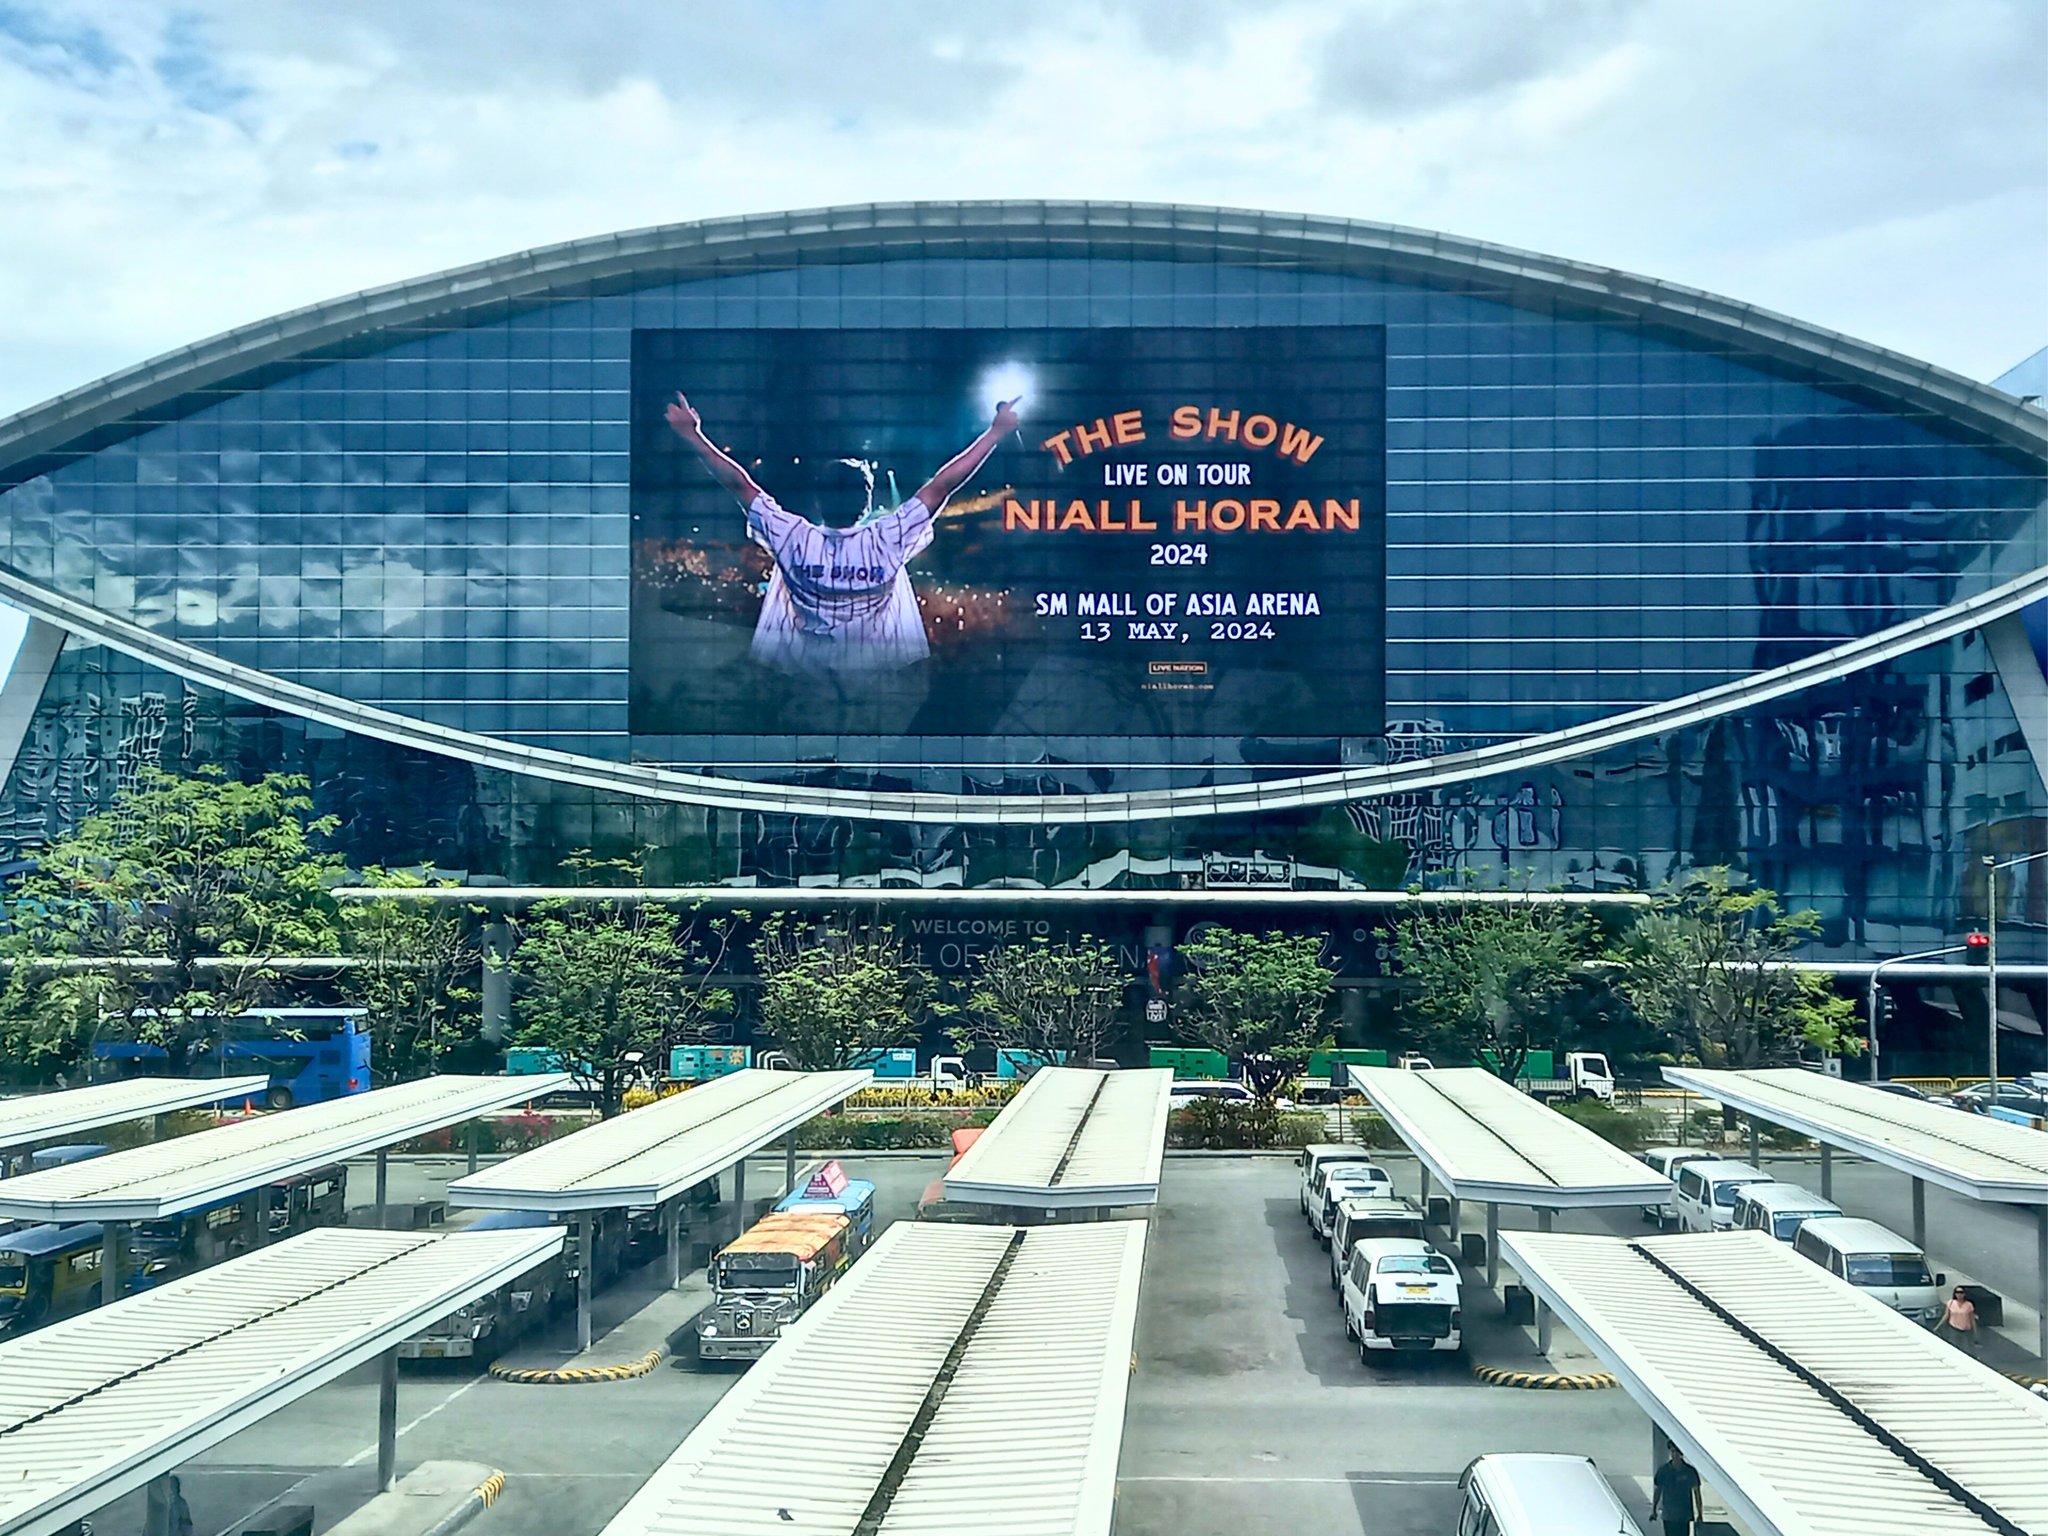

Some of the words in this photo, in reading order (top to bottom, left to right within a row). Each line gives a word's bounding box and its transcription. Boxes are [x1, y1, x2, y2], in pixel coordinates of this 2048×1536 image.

[1042, 409, 1146, 465] THE
[1172, 405, 1324, 464] SHOW
[1104, 464, 1148, 486] LIVE
[1157, 464, 1188, 486] ON
[1197, 464, 1252, 486] TOUR
[1004, 499, 1157, 531] NIALL
[1175, 499, 1361, 531] HORAN
[1150, 544, 1208, 565] 2024
[1036, 593, 1068, 616] SM
[1077, 593, 1137, 616] MALL
[1146, 593, 1177, 616] OF
[1186, 593, 1237, 616] ASIA
[1246, 593, 1320, 616] ARENA
[1080, 622, 1111, 642] 13
[1128, 622, 1189, 643] MAY,
[1210, 622, 1275, 640] 2024
[1152, 664, 1171, 672] LIVE
[1173, 664, 1204, 672] NATION
[912, 919, 1018, 934] WELCOME
[1023, 920, 1050, 934] TO
